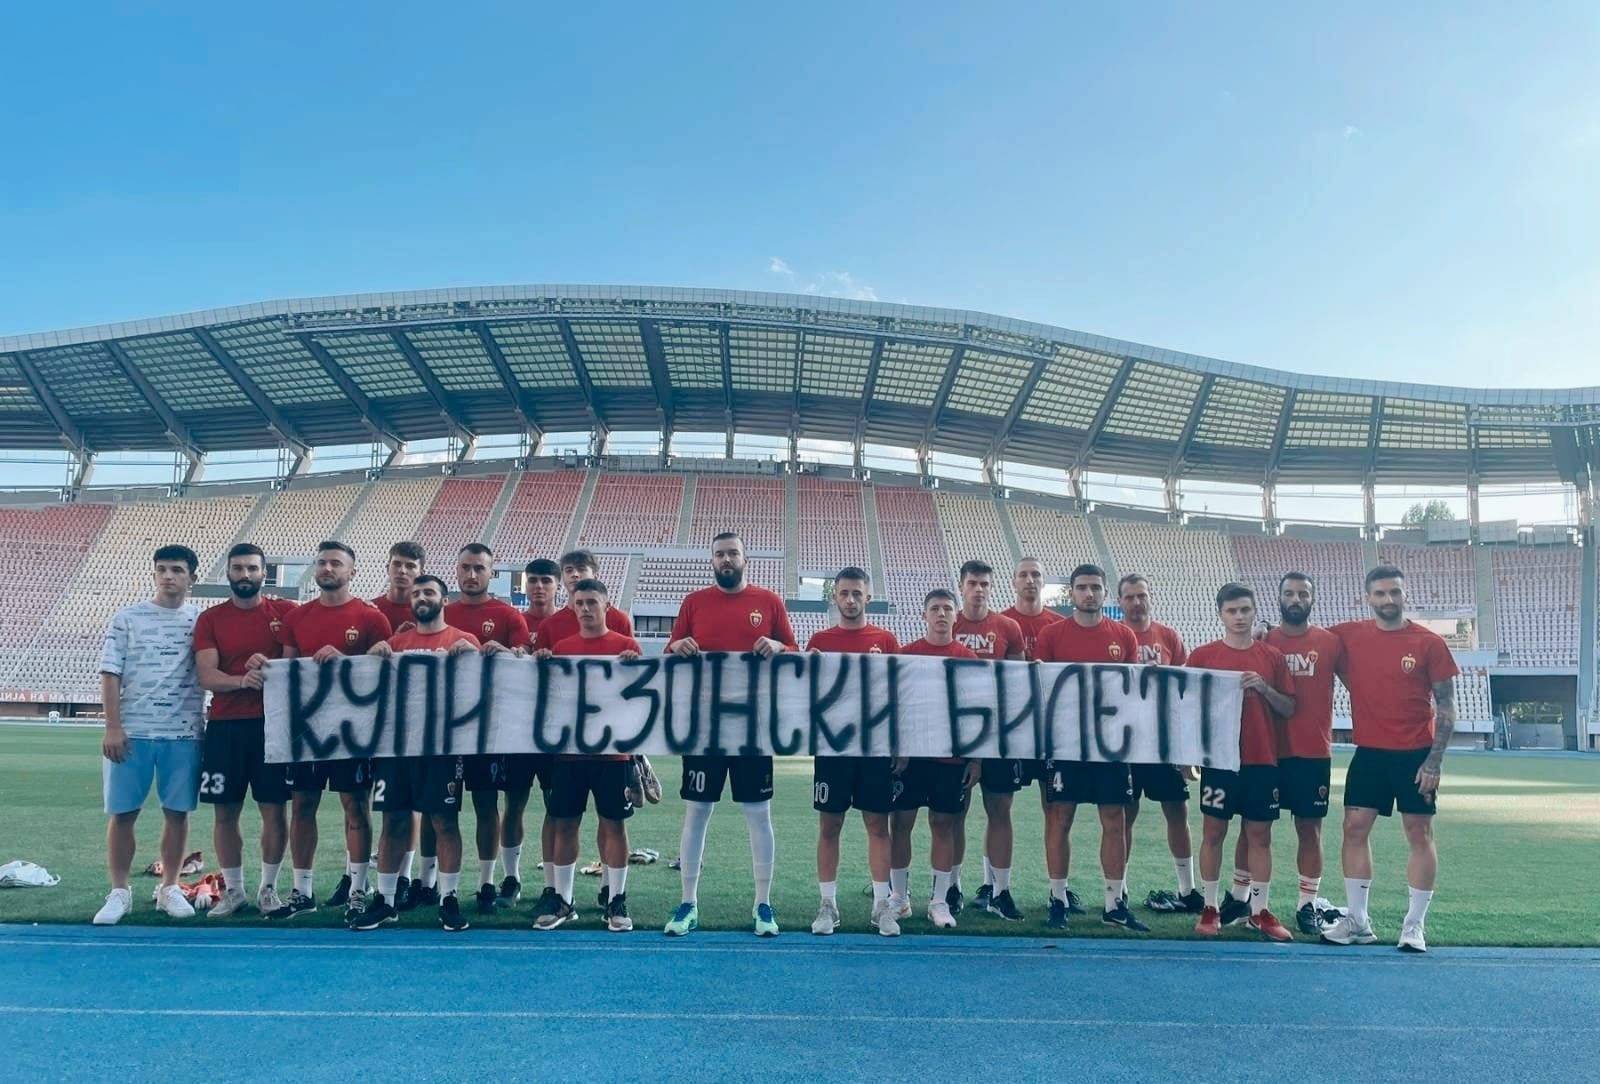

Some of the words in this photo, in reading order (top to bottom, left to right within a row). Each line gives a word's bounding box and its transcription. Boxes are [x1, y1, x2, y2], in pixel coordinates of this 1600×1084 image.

[288, 654, 494, 761] КУПИ
[532, 651, 898, 756] СЕЗОНСКИ
[200, 771, 225, 794] 23
[688, 770, 706, 793] 20
[815, 782, 829, 804] 10
[1052, 771, 1064, 793] 4
[1202, 786, 1226, 809] 22
